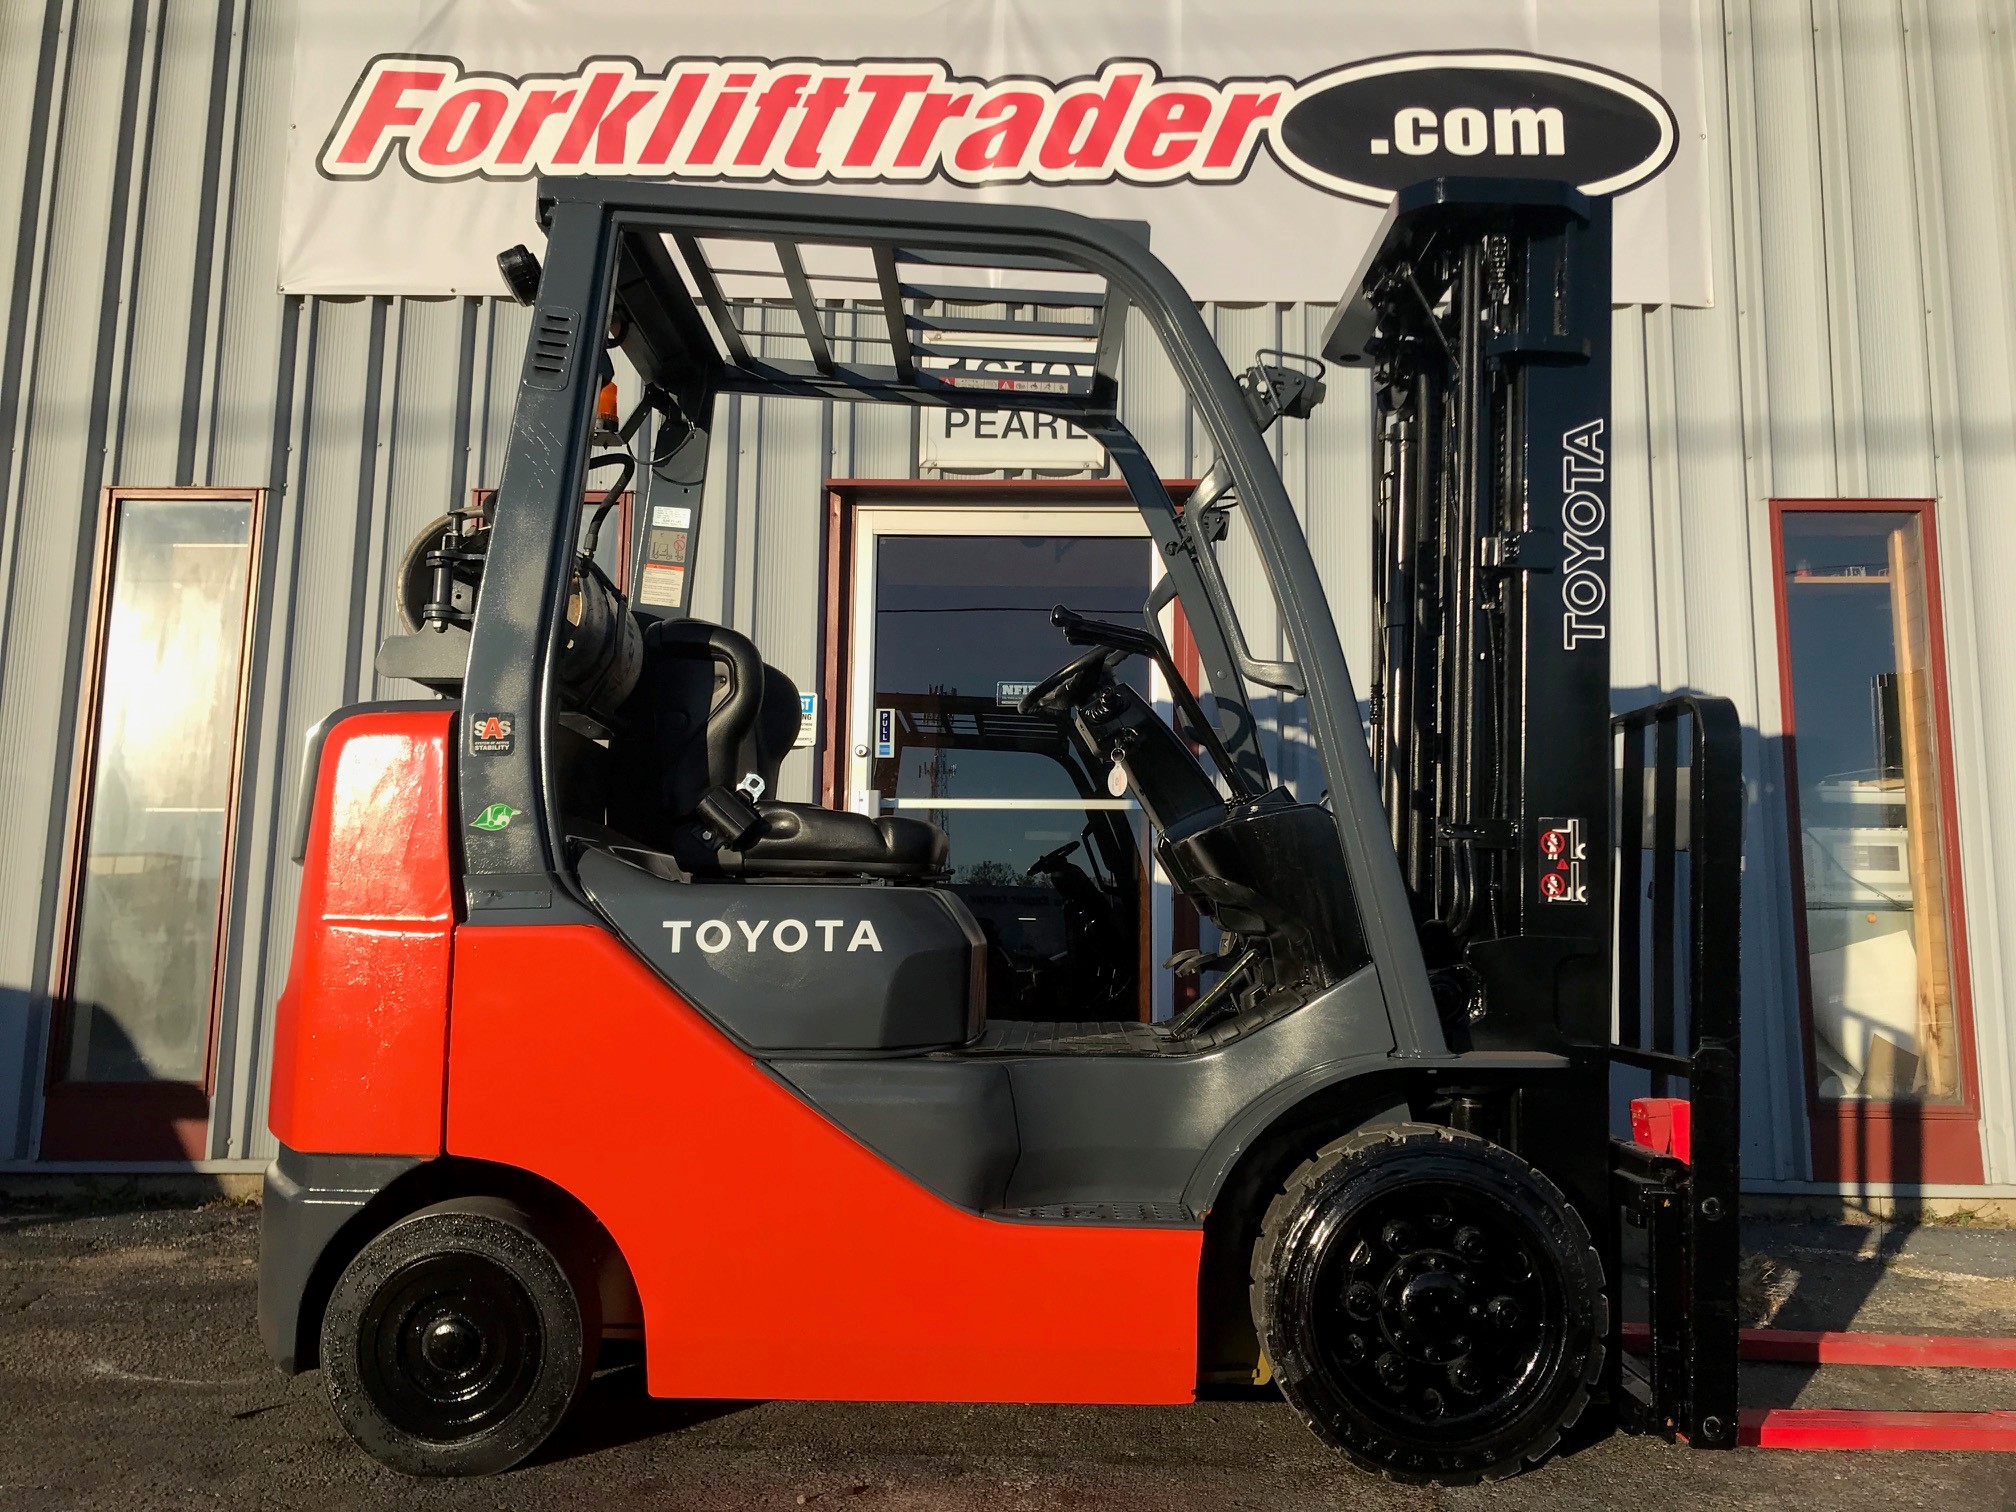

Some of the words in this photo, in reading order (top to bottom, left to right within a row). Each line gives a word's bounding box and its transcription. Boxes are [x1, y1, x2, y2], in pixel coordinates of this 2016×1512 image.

[334, 69, 1282, 171] ForkliftTrader
[1370, 106, 1566, 156] .com
[945, 408, 1088, 439] PEARL
[1561, 418, 1606, 651] TOYOTA
[474, 717, 511, 739] SAS
[662, 918, 883, 954] TOYOTA
